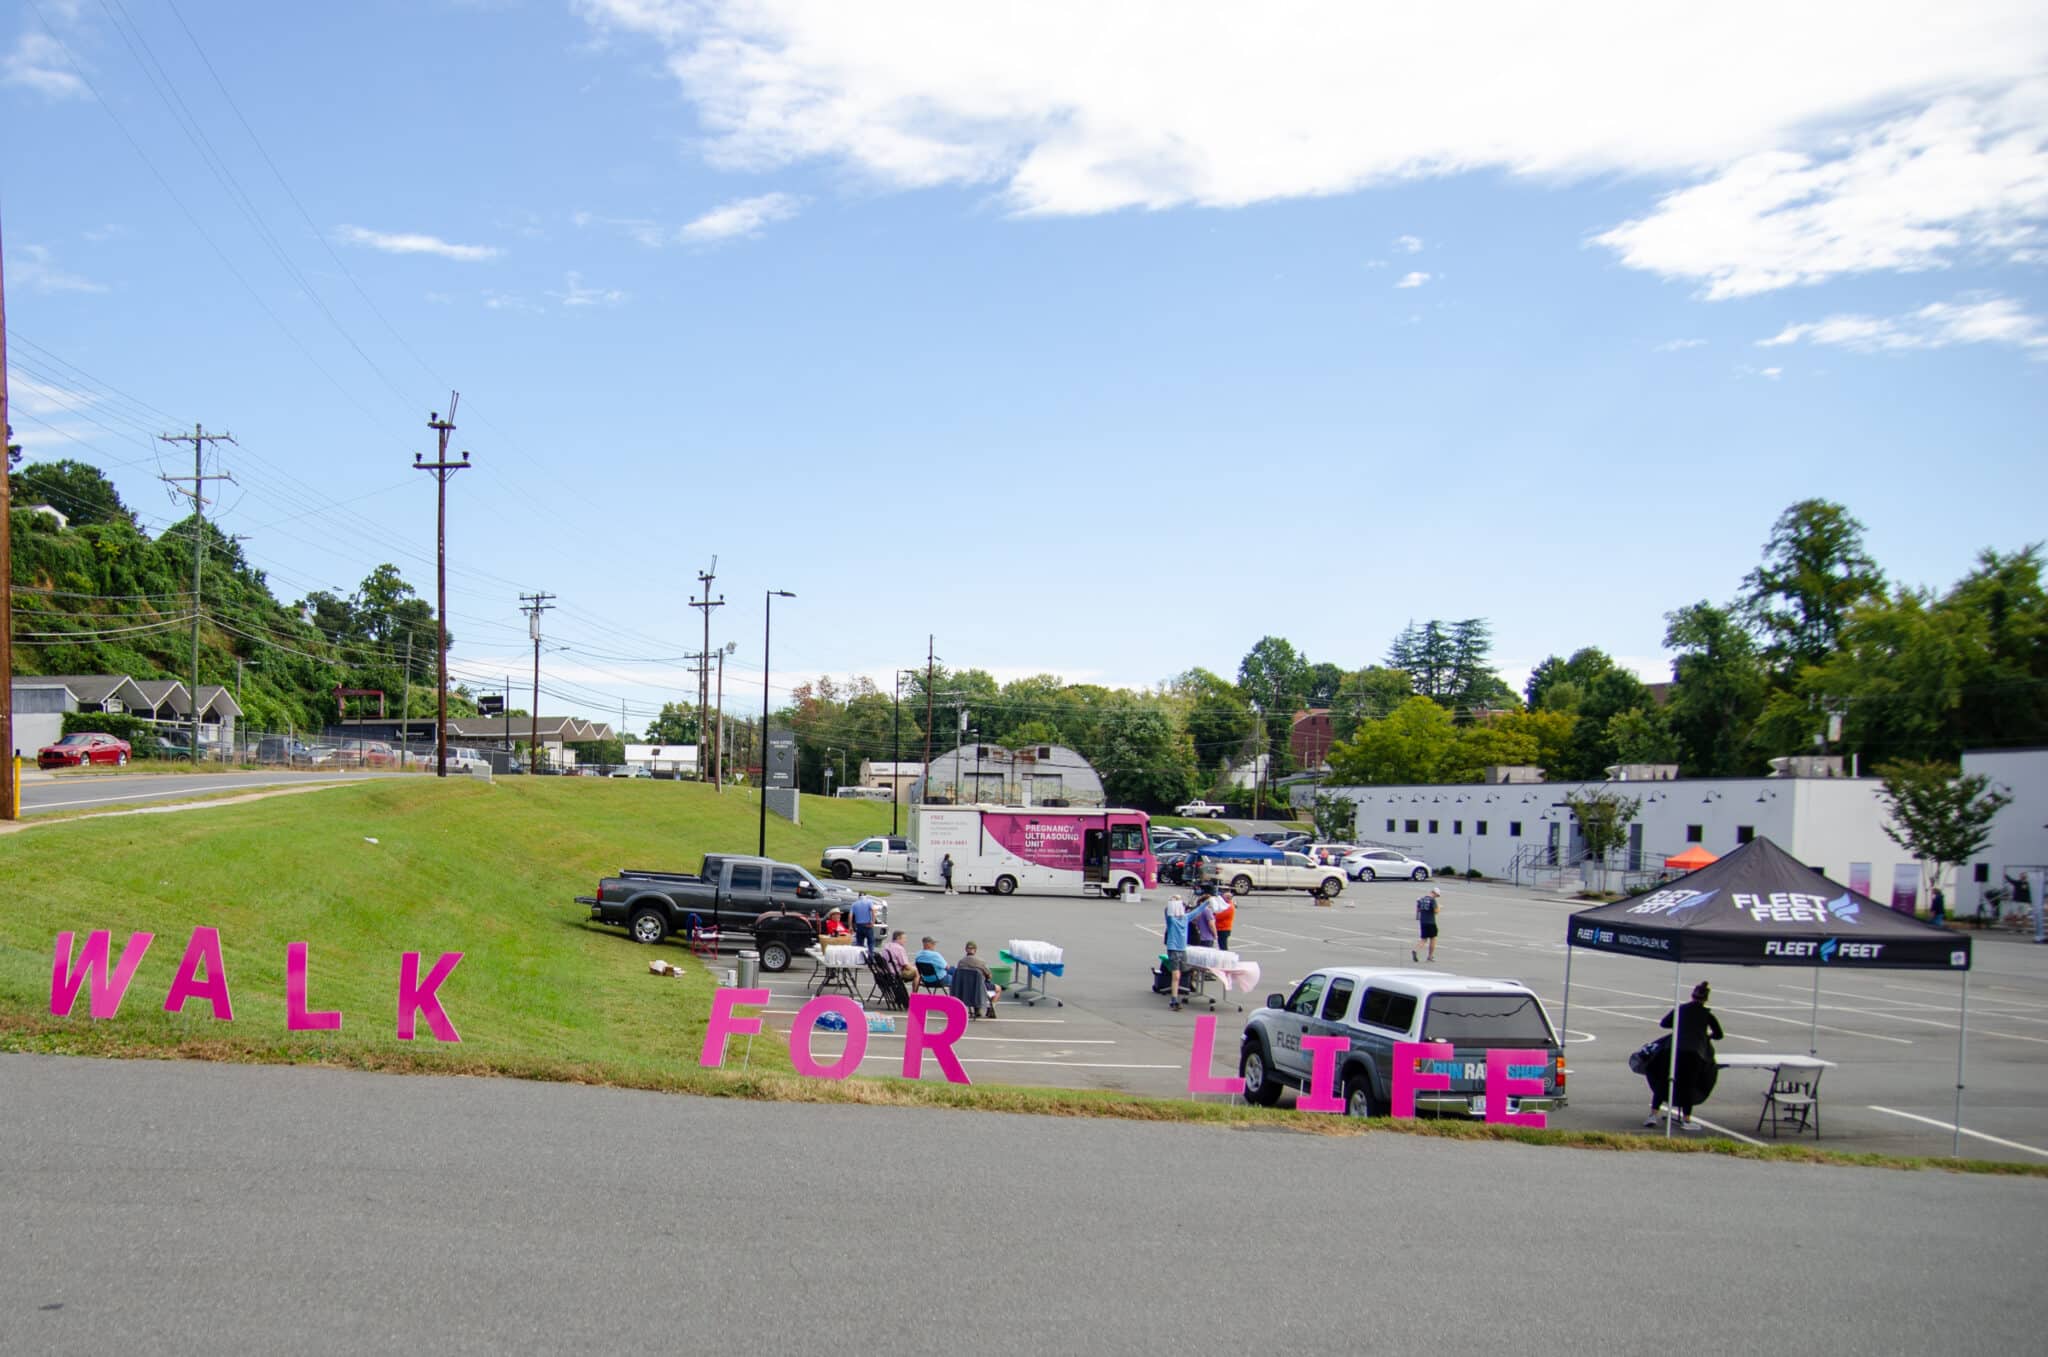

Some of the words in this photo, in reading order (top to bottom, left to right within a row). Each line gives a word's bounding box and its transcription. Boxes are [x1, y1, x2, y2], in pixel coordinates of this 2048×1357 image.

[1025, 824, 1074, 833] PREGNANCY
[1025, 832, 1079, 841] ULTRASOUND
[1025, 840, 1044, 848] UNIT
[1731, 893, 1828, 910] FLEET
[1750, 907, 1828, 922] FEET
[1577, 928, 1593, 940] FLEET
[1599, 931, 1614, 943] FEET
[1764, 941, 1817, 956] FLEET
[1838, 943, 1885, 958] FEET
[50, 926, 464, 1042] WALK
[699, 987, 971, 1084] FOR
[1188, 1015, 1548, 1128] LIFE
